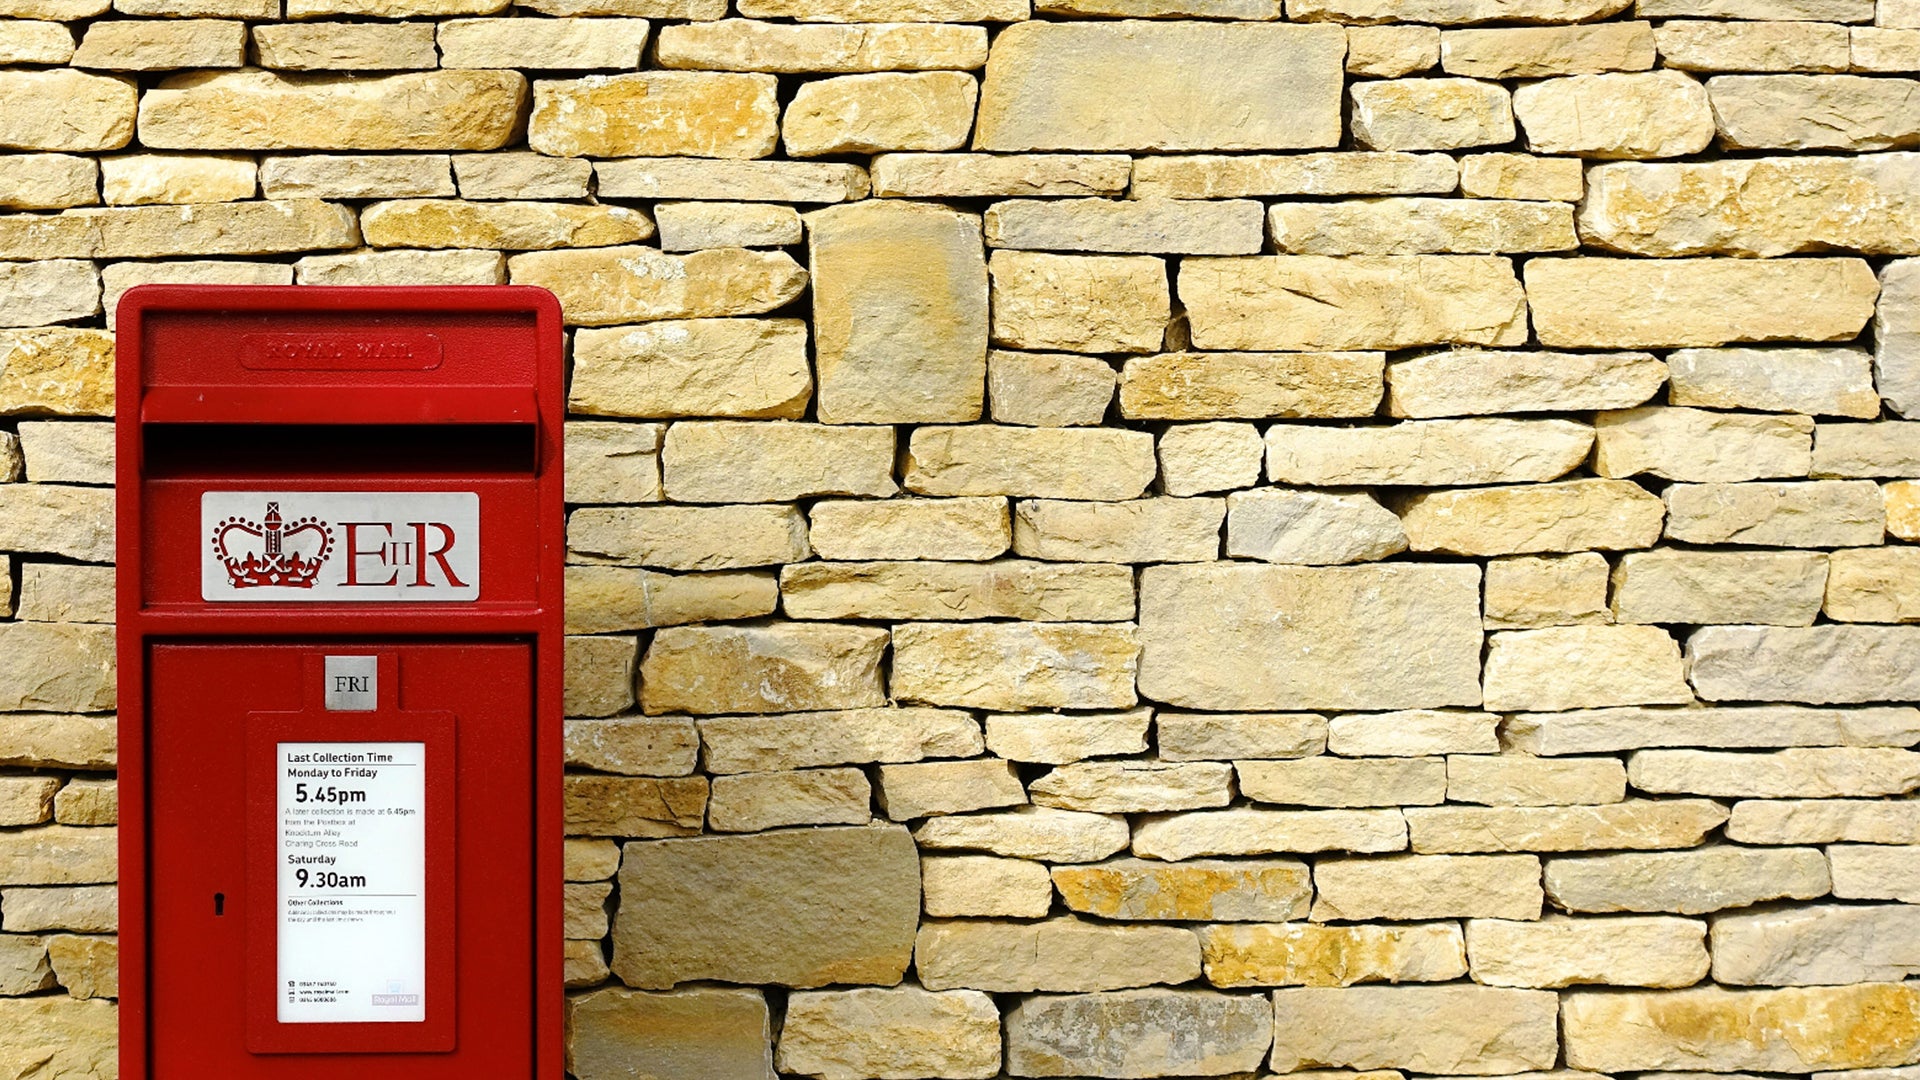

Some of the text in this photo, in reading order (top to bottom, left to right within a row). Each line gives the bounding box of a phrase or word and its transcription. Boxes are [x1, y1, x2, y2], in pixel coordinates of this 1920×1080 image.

[266, 343, 413, 358] ROYAL MAIL
[334, 676, 369, 692] FRI
[287, 752, 393, 762] Last Collection Time
[287, 768, 378, 779] Monday to Friday
[296, 783, 366, 805] 5.45pm
[288, 854, 336, 866] Saturday
[296, 868, 366, 888] 9.30am
